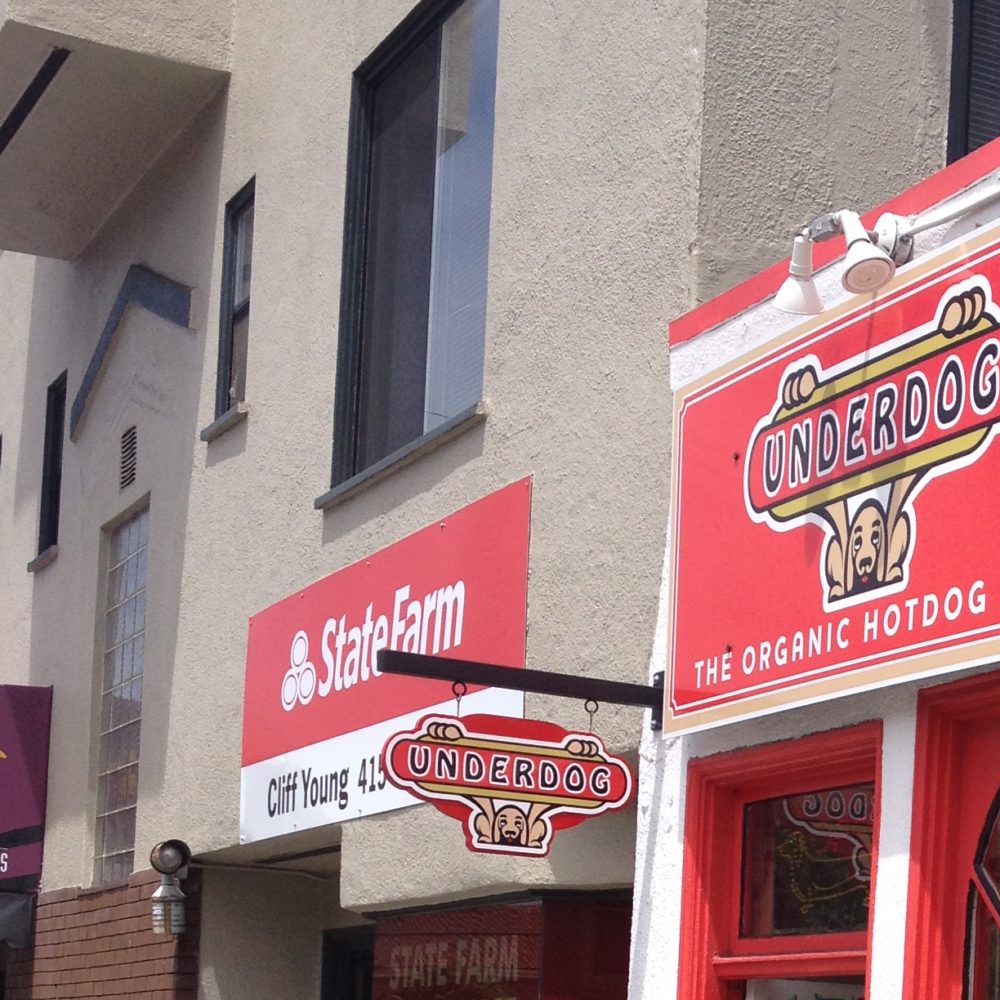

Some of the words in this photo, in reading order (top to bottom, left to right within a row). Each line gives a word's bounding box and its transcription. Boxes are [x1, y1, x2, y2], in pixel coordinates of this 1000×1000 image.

[694, 653, 732, 689] THE
[742, 617, 850, 675] ORGANIC
[863, 580, 987, 641] HOTDOG
[267, 776, 298, 819] Cliff
[301, 756, 350, 811] Young
[408, 745, 613, 797] UNDERDOG
[389, 942, 448, 991] STATE
[456, 934, 518, 984] FARM
